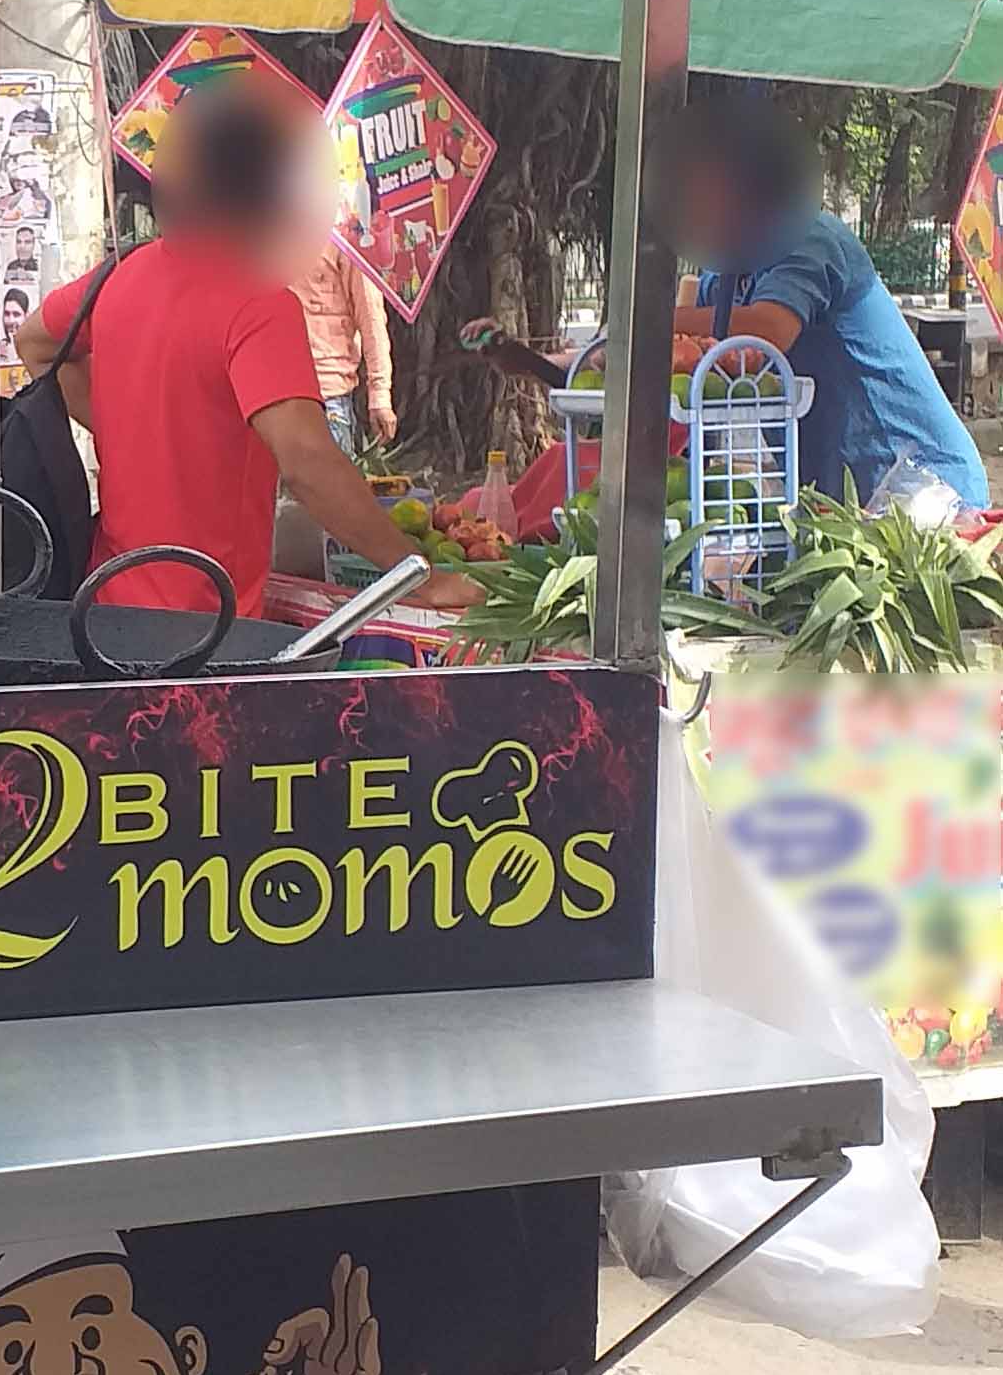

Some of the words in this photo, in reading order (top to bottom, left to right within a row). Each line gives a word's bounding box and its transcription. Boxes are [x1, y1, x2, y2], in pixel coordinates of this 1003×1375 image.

[360, 99, 427, 166] FRUIT
[98, 757, 411, 845] BITE
[108, 829, 616, 952] momos
